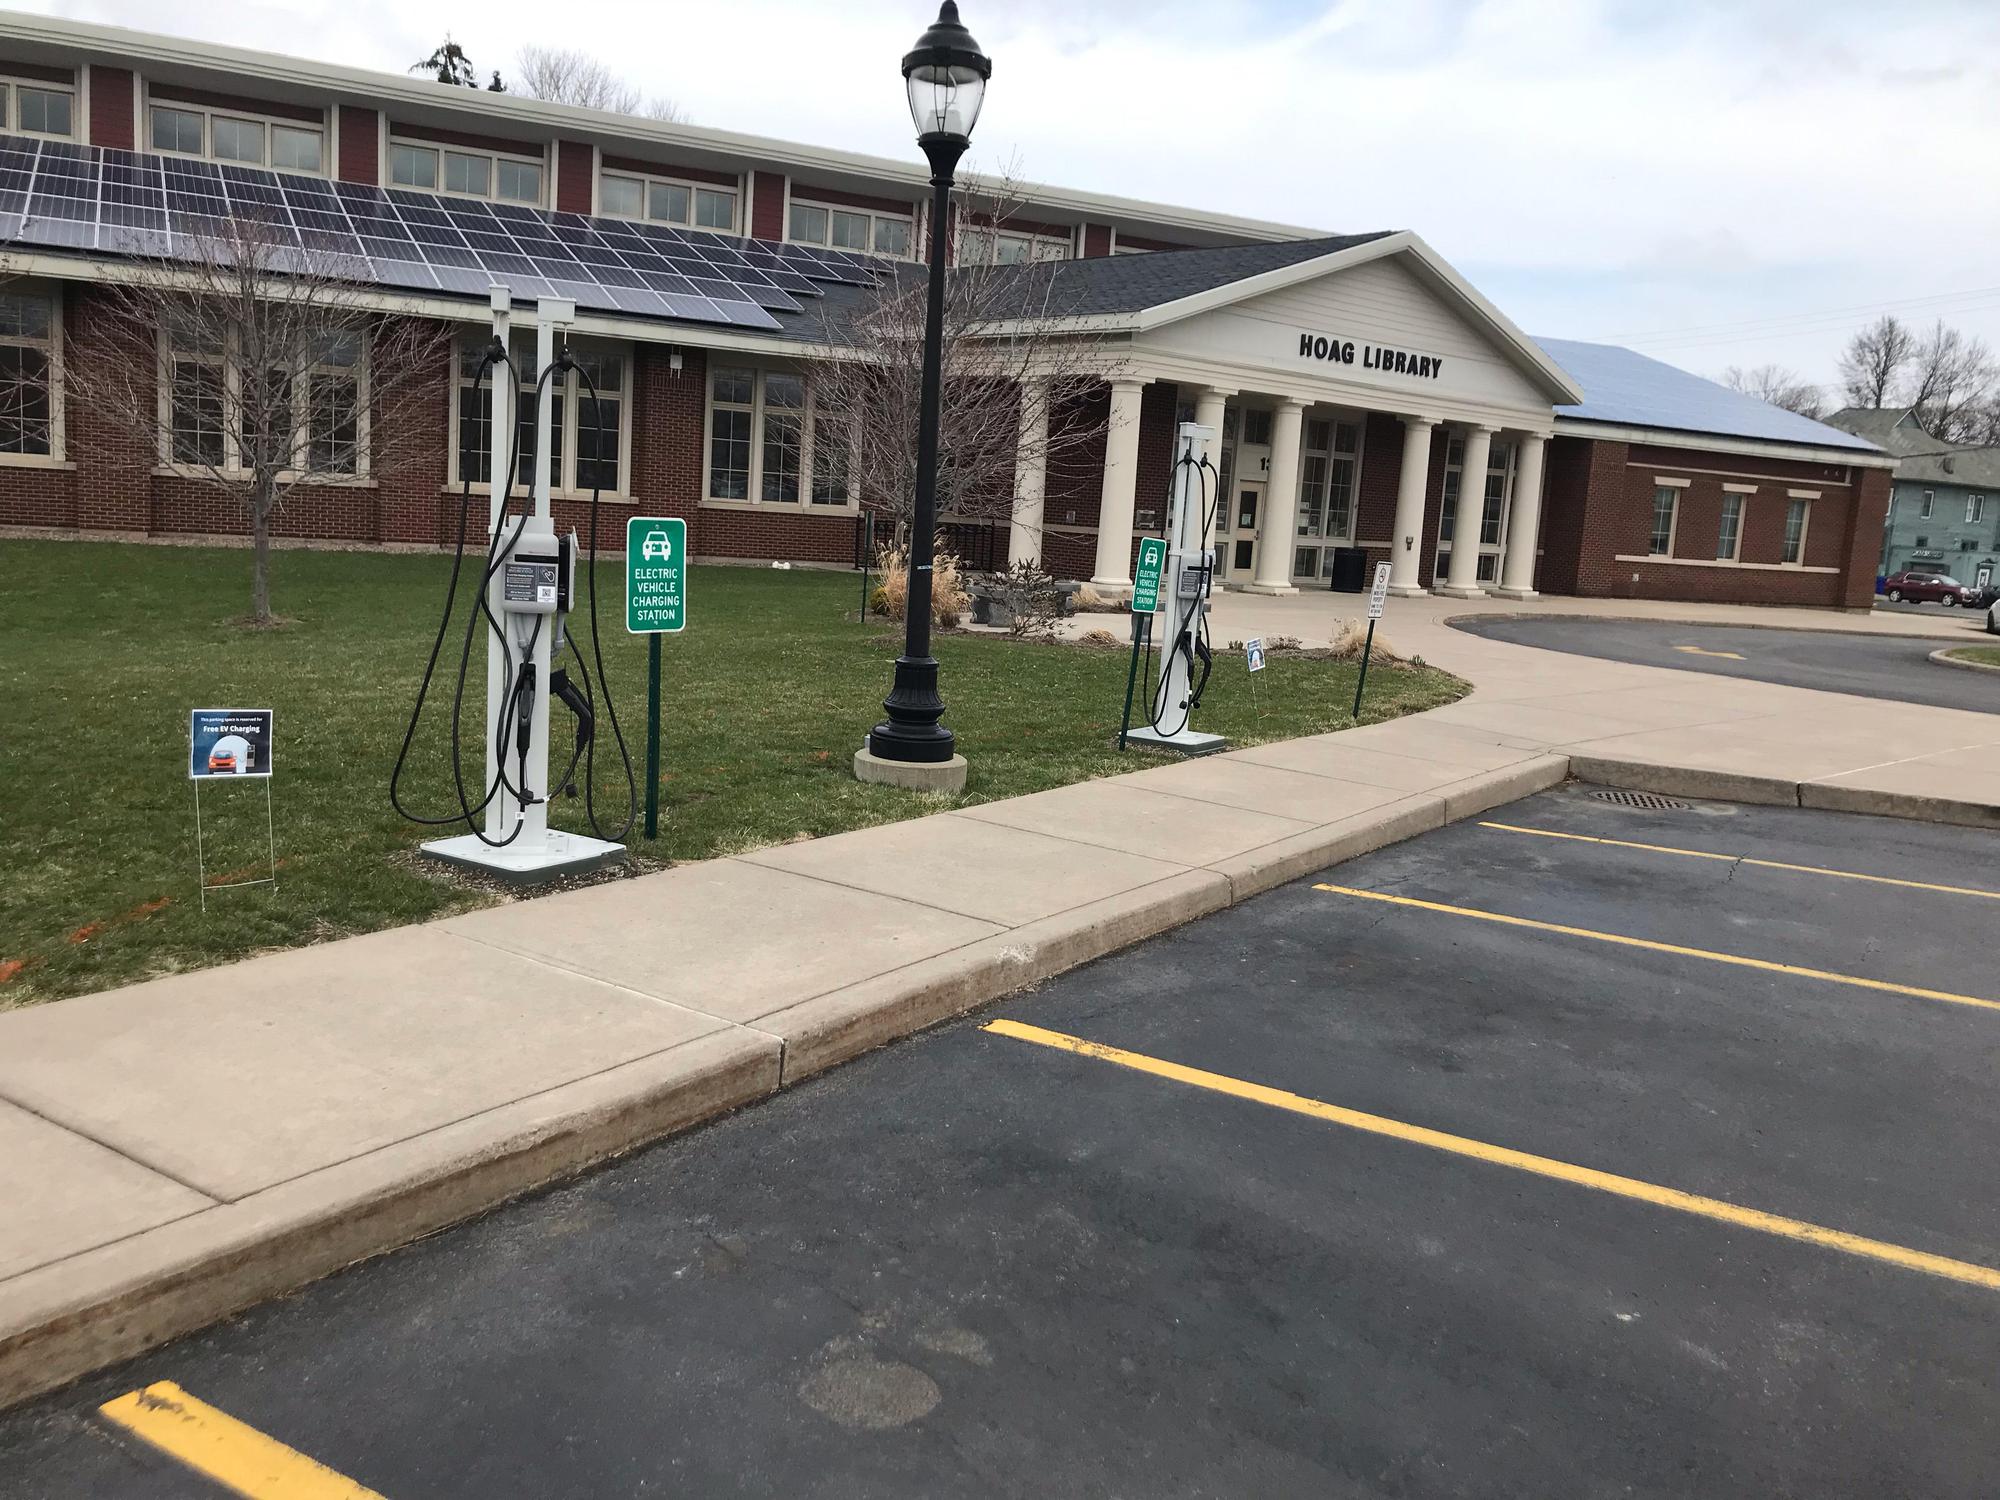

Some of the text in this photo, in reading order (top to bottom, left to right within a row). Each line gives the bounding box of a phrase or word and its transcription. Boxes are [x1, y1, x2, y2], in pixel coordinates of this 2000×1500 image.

[1300, 333, 1443, 379] HOAG LIBRARY
[635, 568, 678, 579] ELECTRIC
[1139, 569, 1158, 579] ELECTRIC
[637, 582, 676, 593] VEHICLE
[1139, 578, 1156, 588] VEHICLE
[1136, 587, 1157, 597] CHARGING
[632, 595, 680, 607] CHARGING
[1136, 596, 1153, 605] STATION
[637, 609, 675, 620] STATION
[203, 724, 260, 734] Free EV Charging
